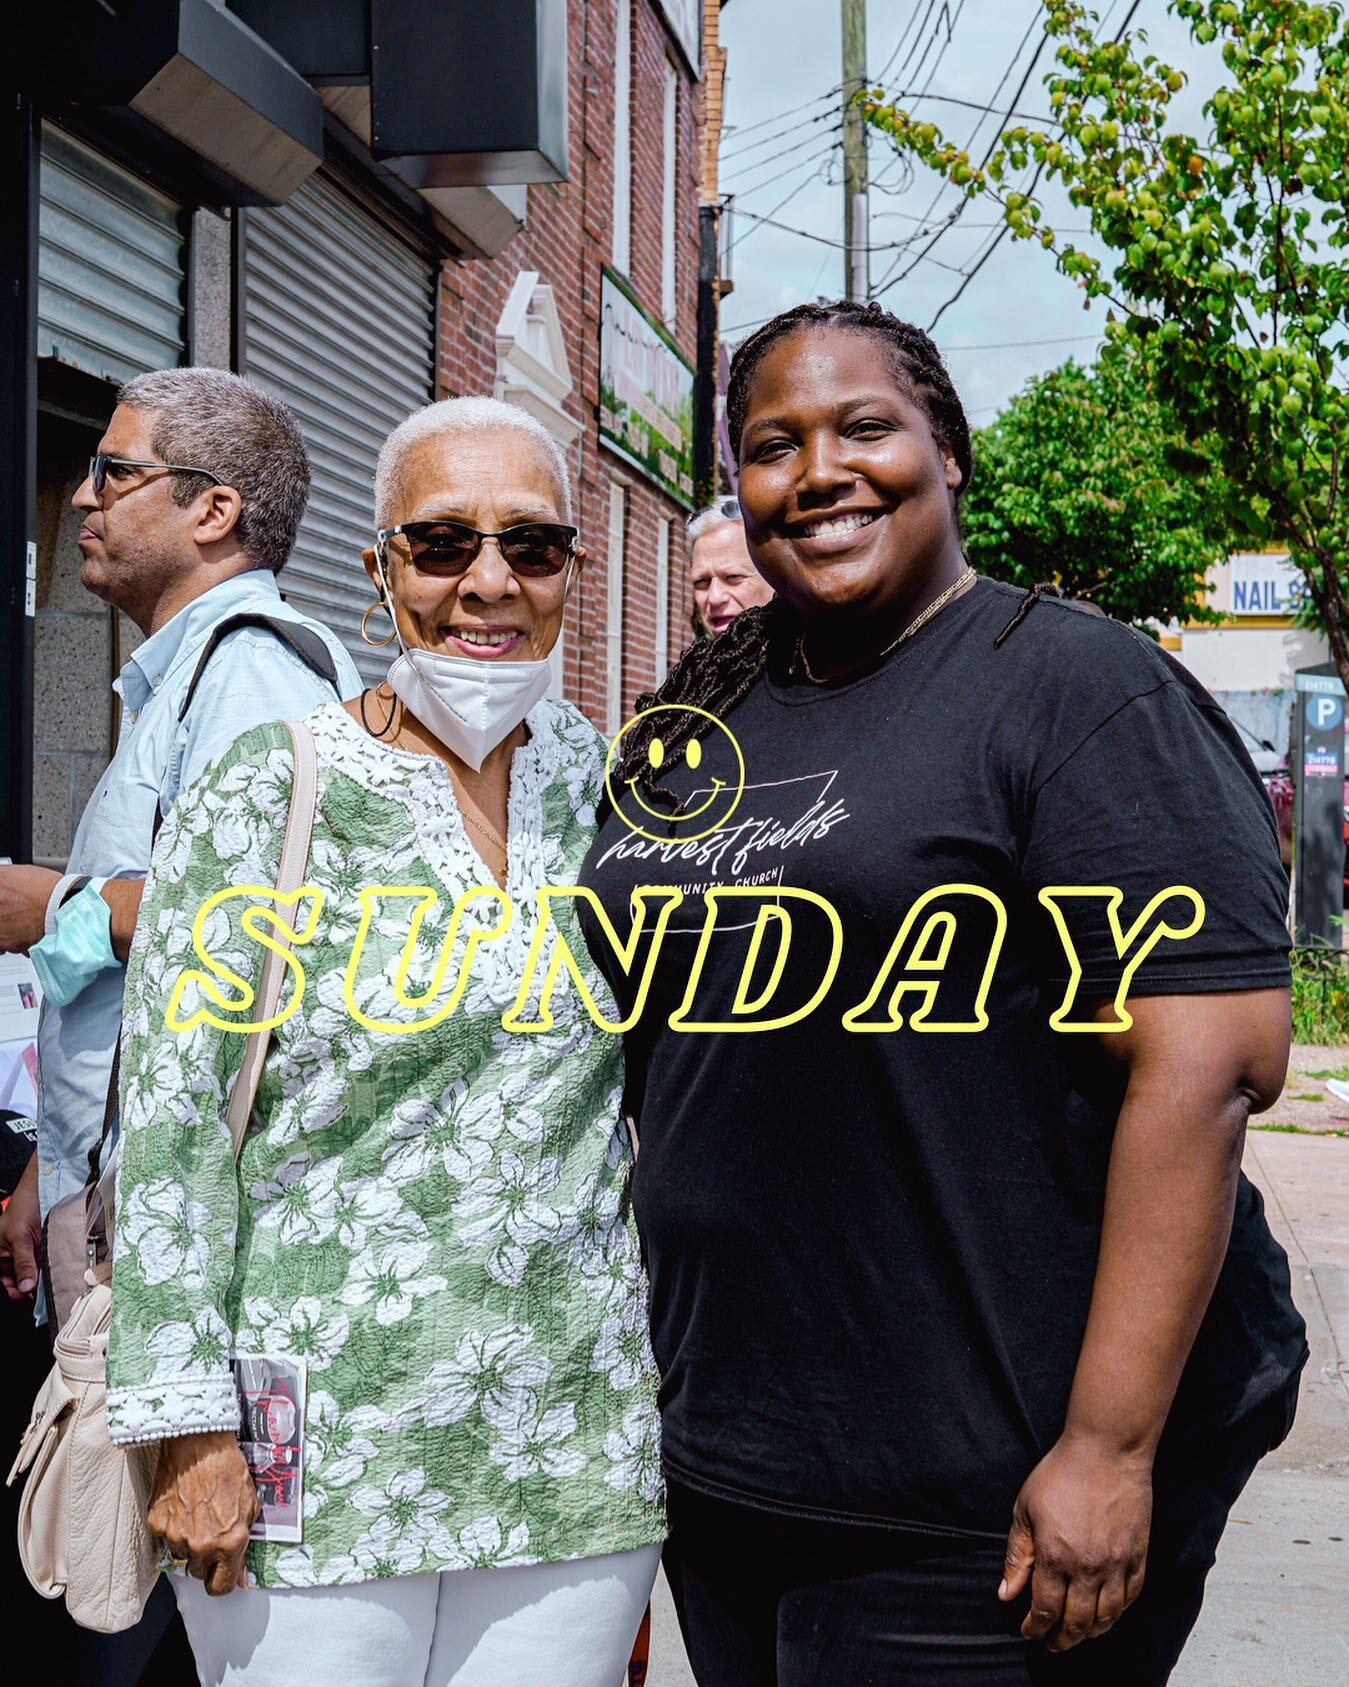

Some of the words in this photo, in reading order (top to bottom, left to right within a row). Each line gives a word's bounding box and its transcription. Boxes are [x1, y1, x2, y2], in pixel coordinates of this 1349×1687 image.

[1234, 581, 1281, 610] NAIL
[1318, 698, 1336, 726] P
[645, 881, 725, 896] UNITY
[735, 867, 779, 888] CHURCH
[13, 1119, 37, 1131] JESU
